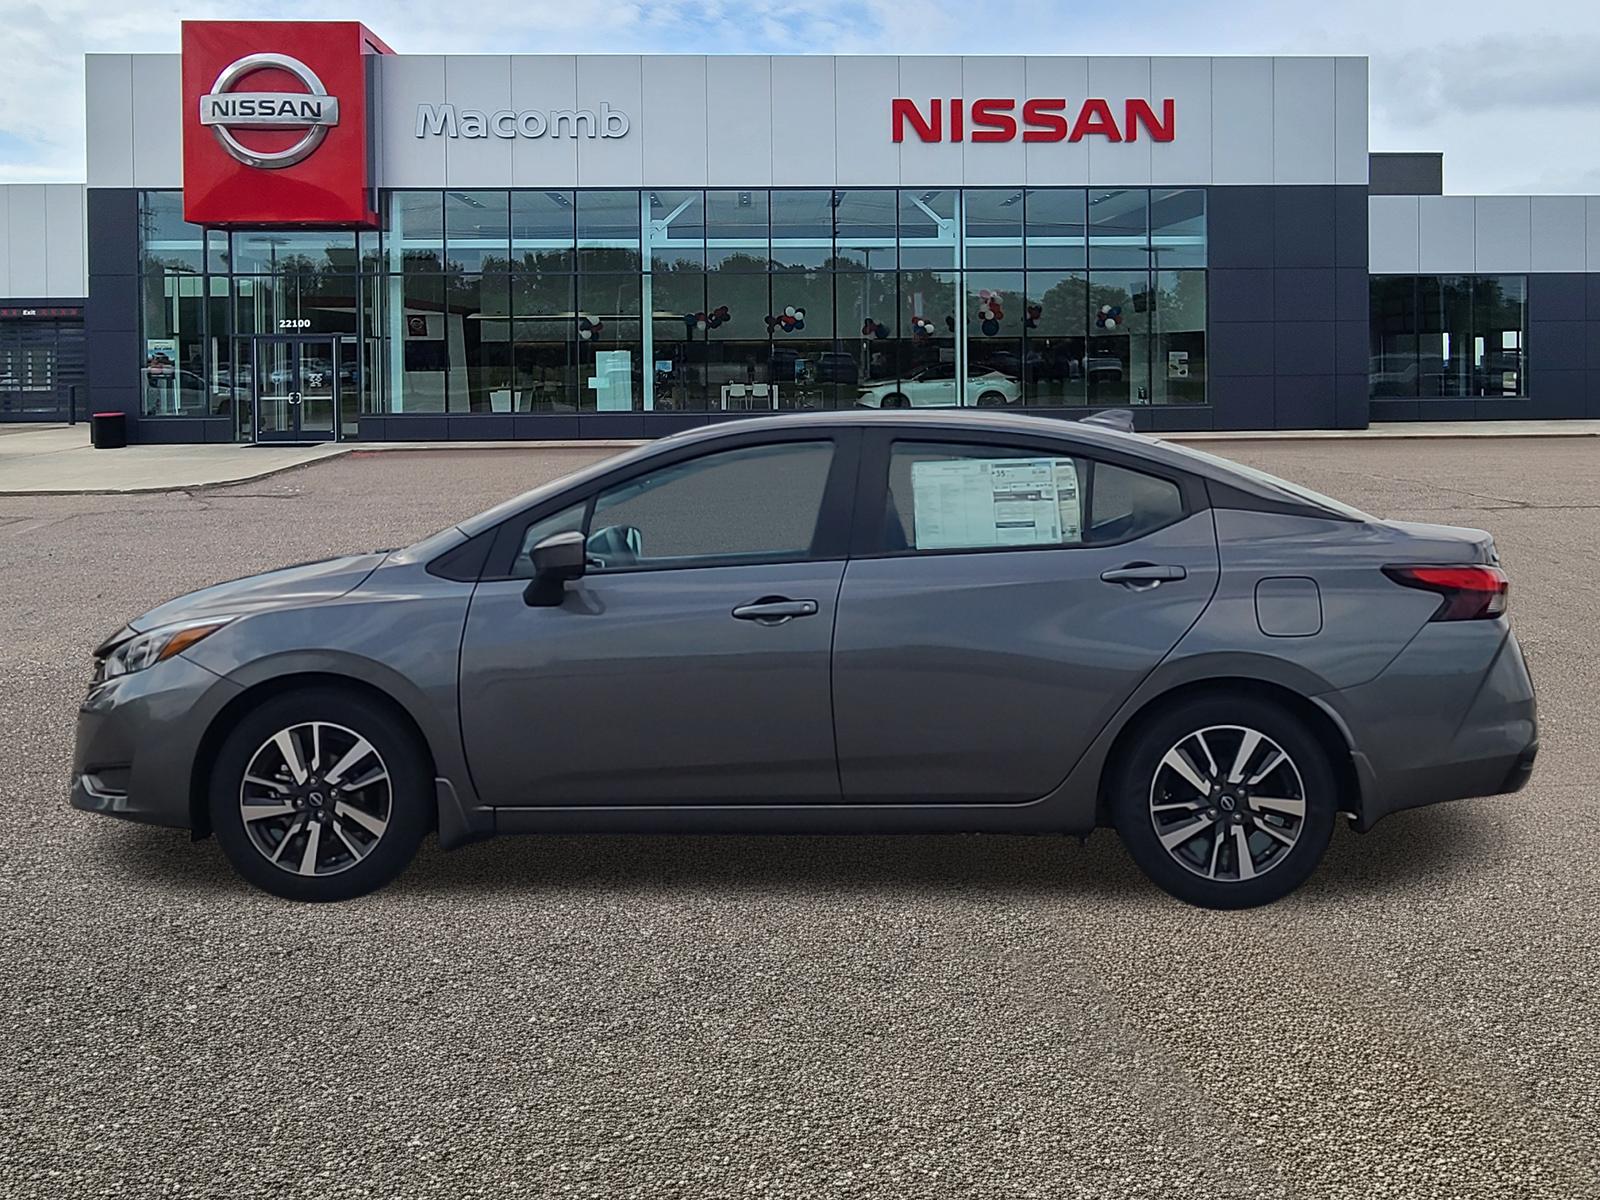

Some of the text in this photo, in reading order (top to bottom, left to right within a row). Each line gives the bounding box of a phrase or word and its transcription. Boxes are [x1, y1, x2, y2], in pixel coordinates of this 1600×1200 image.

[212, 100, 322, 117] NISSAN
[415, 102, 630, 139] Macomb
[892, 98, 1175, 143] NISSAN
[279, 319, 311, 328] 22100
